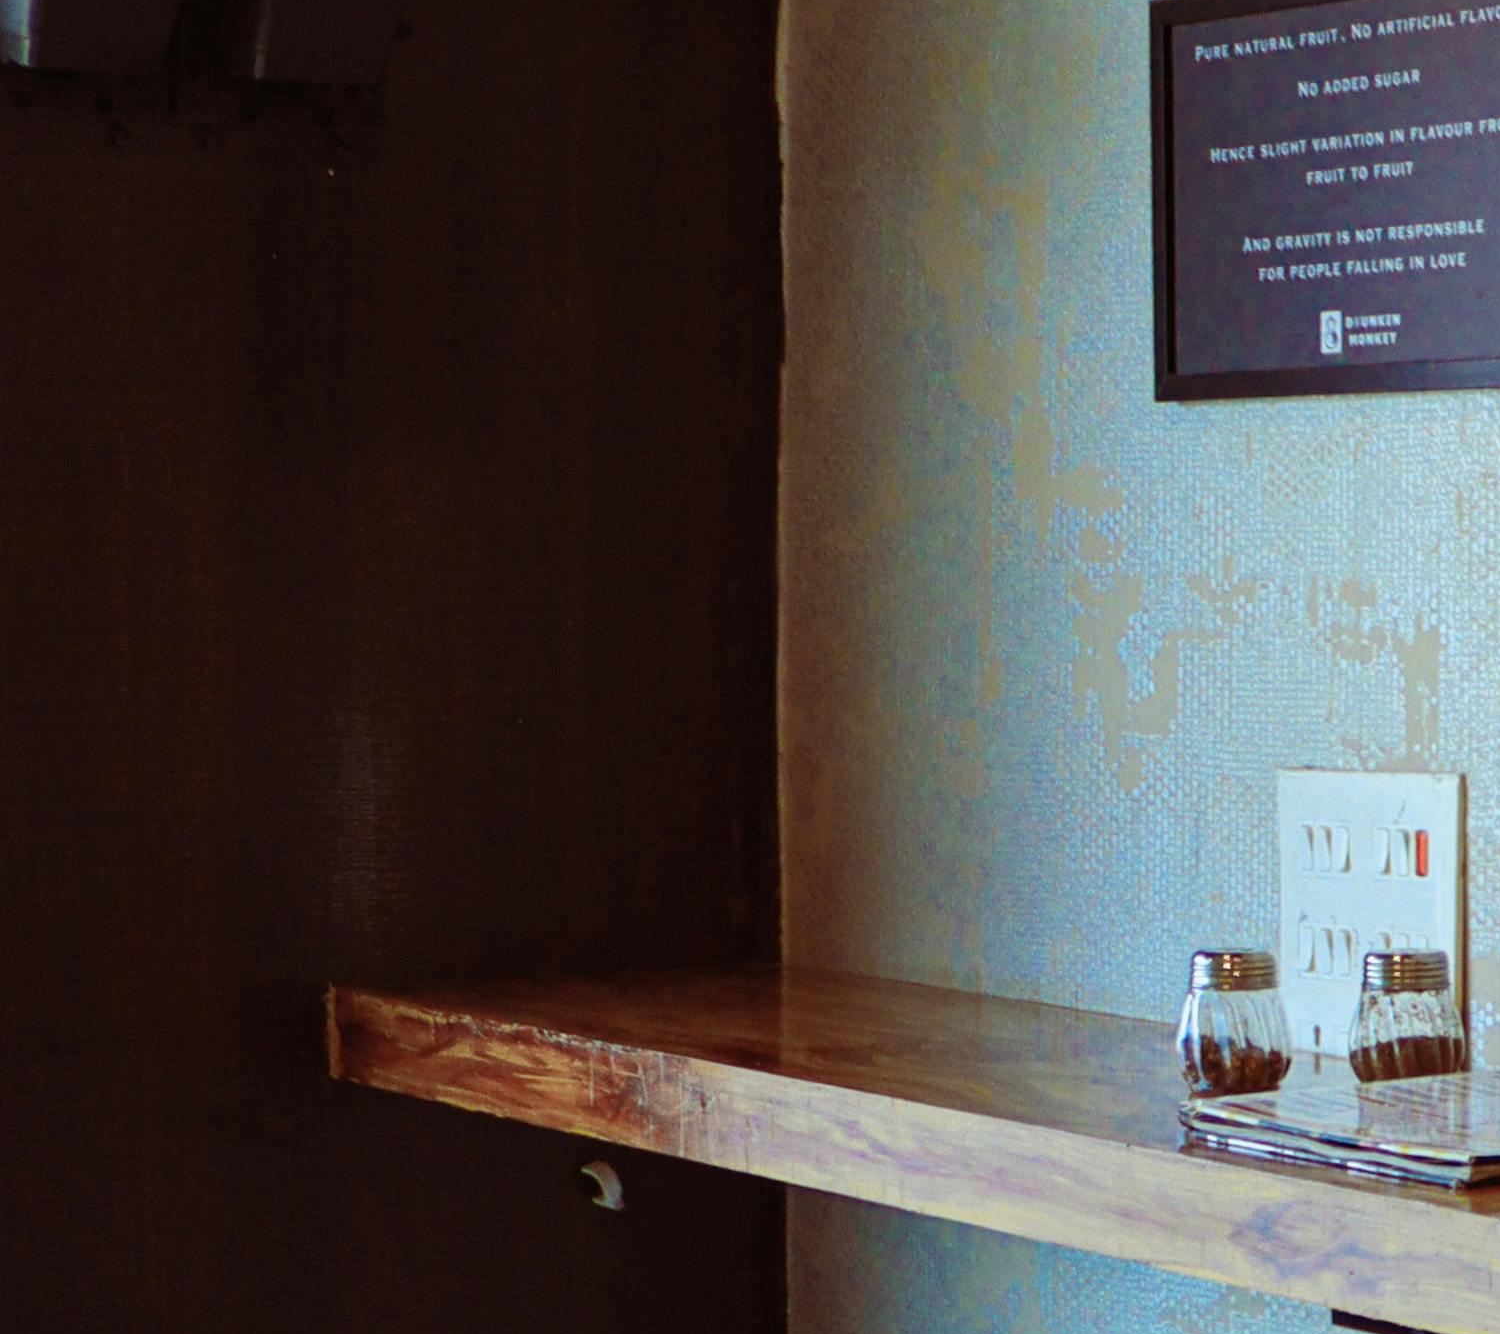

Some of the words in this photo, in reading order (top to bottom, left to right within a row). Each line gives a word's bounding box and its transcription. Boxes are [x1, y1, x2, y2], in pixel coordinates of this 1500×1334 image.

[1194, 43, 1230, 63] PURE
[1233, 35, 1296, 57] NATURAL
[1350, 22, 1373, 41] NO
[1376, 12, 1456, 36] ARTIFICIAL
[1297, 81, 1319, 98] NO
[1322, 75, 1370, 95] ADDED
[1373, 68, 1421, 89] SUGAR
[1209, 144, 1255, 164] HENCE
[1259, 138, 1308, 159] SLIGHT
[1311, 130, 1386, 153] VARIATION
[1389, 128, 1406, 145] IN
[1409, 120, 1474, 142] FLAVOUR
[1305, 167, 1346, 186] FRUIT
[1349, 165, 1370, 182] TO
[1372, 160, 1415, 179] FRUIT
[1242, 236, 1272, 254] AND
[1274, 231, 1333, 252] GRAVITY
[1335, 229, 1351, 246] IS
[1354, 226, 1384, 244] NOT
[1387, 218, 1486, 241] RESPONSIBLE
[1257, 265, 1286, 282] FOR
[1289, 261, 1342, 280] PEOPLE
[1345, 256, 1405, 276] FALLING
[1408, 255, 1425, 270] IN
[1429, 251, 1467, 270] LOVE
